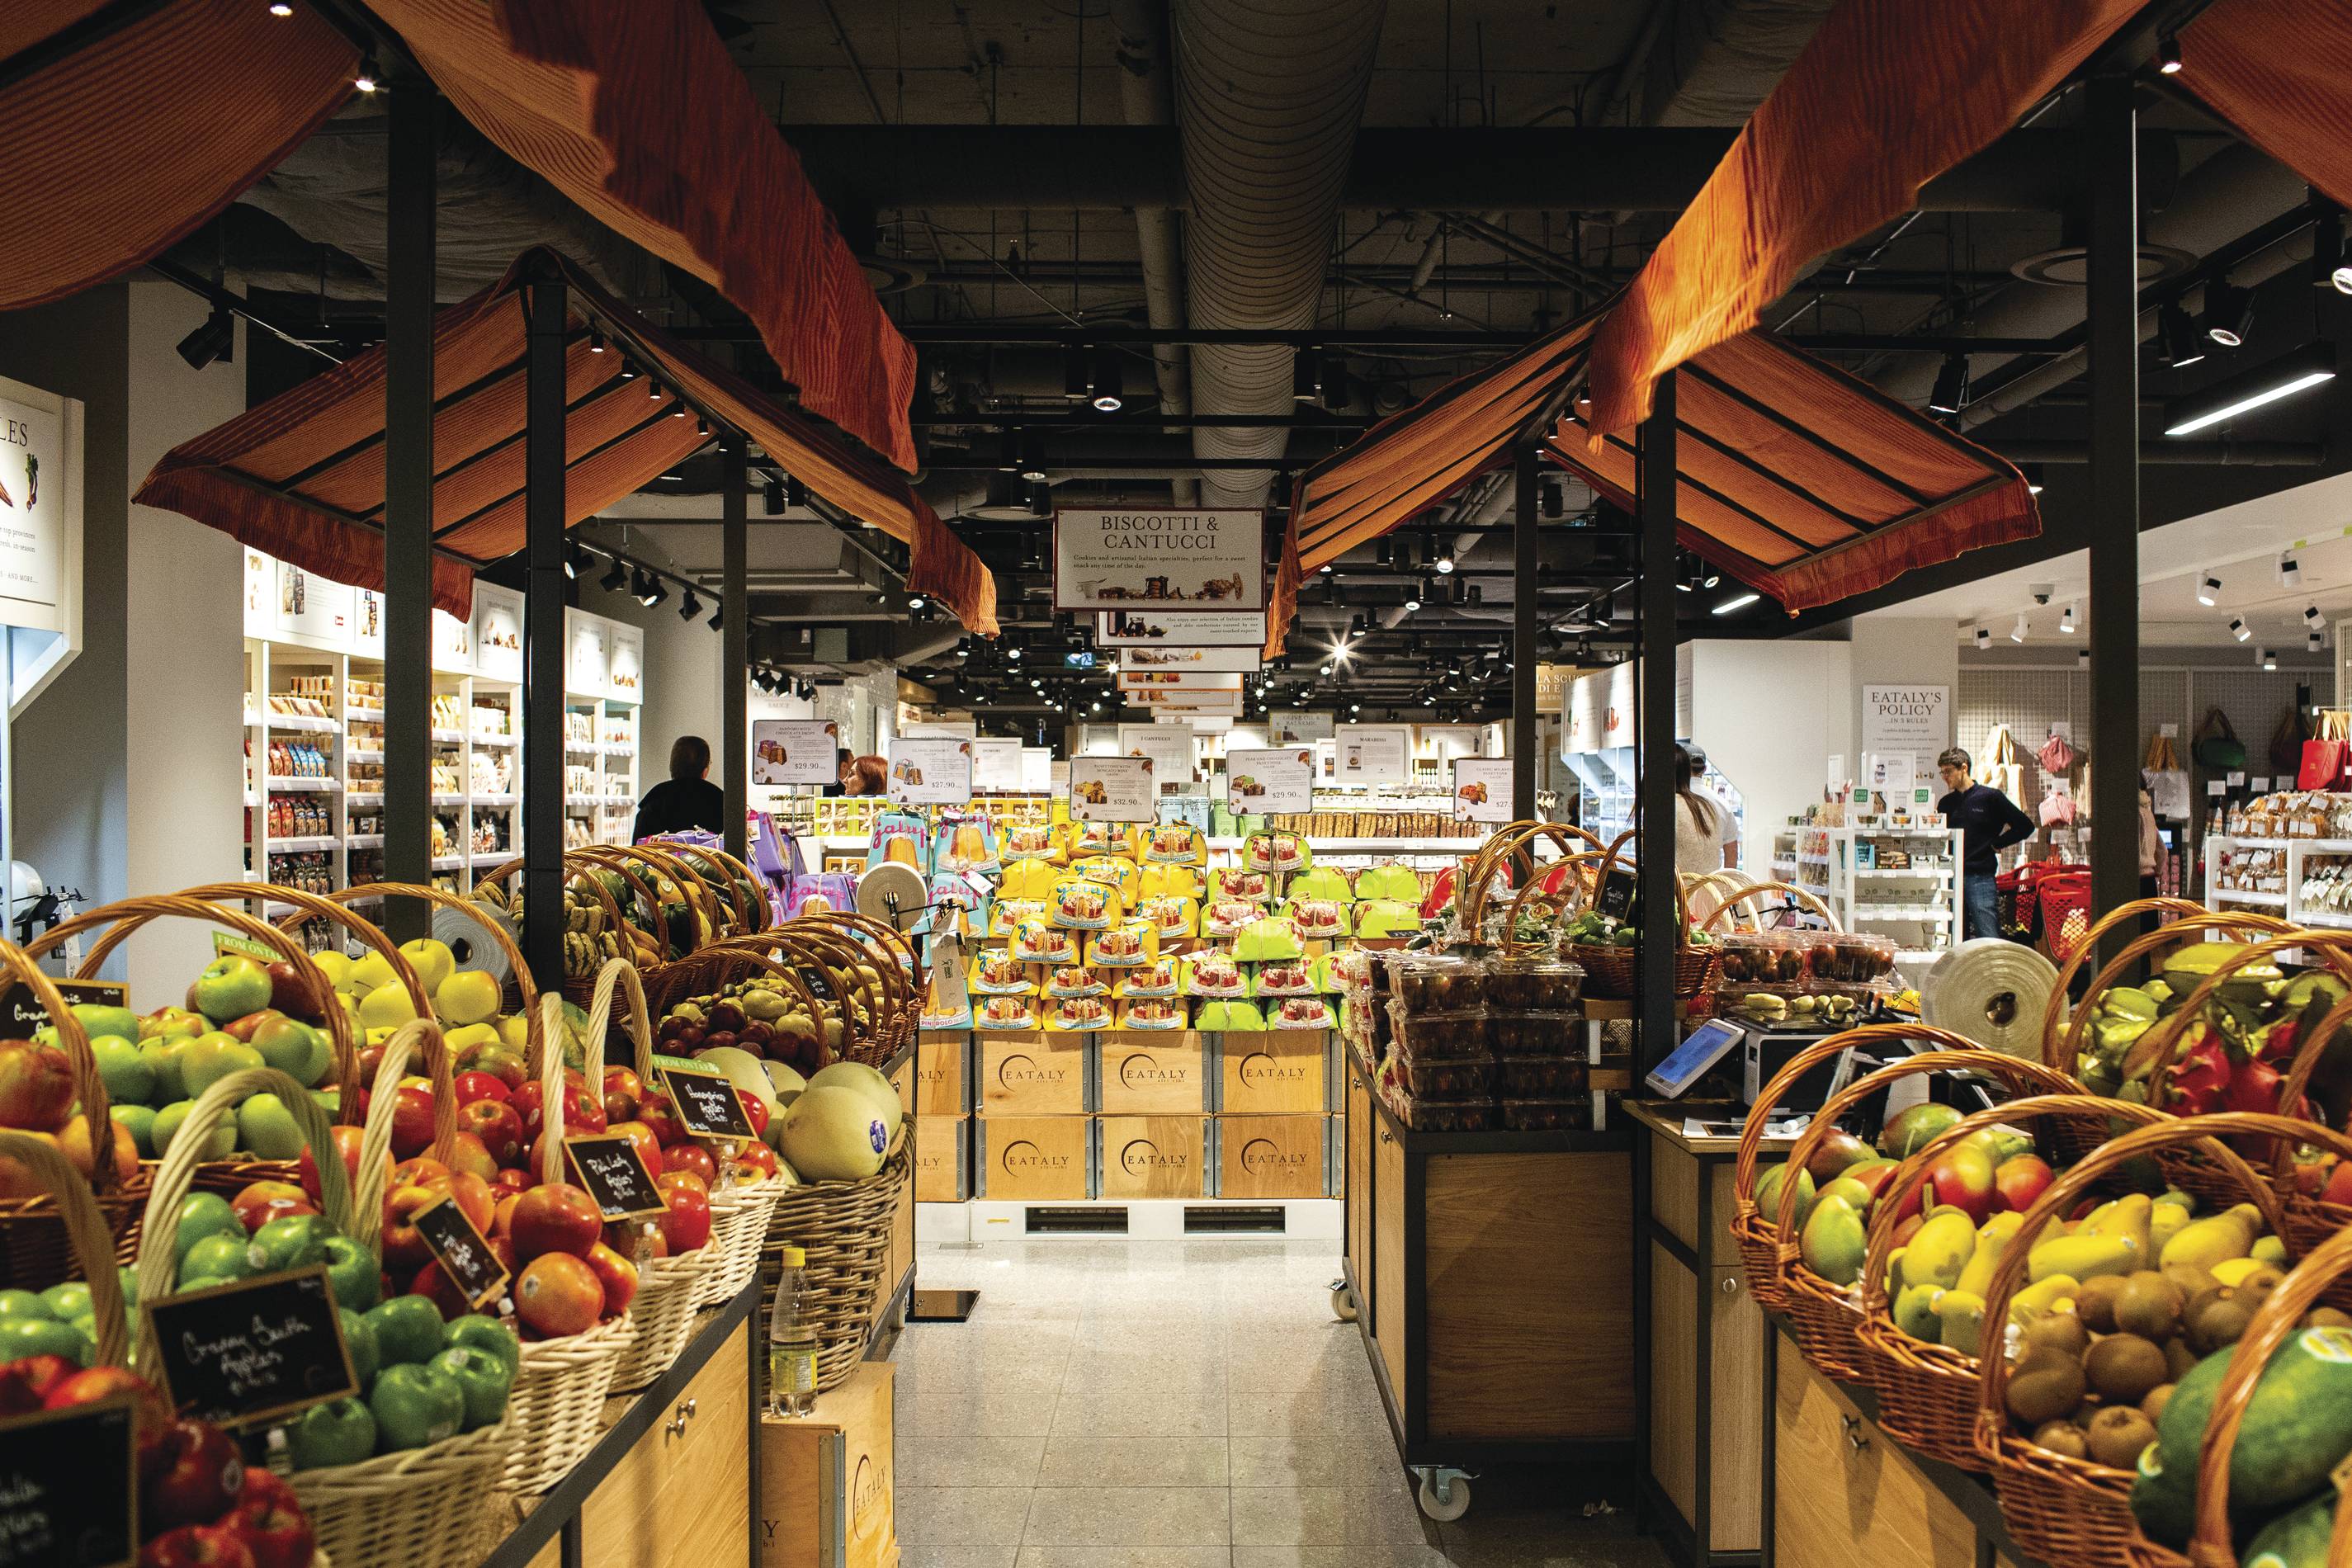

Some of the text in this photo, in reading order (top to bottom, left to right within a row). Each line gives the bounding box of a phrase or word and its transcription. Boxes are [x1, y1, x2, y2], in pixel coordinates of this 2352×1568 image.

[1101, 516, 1220, 531] BISCOTTI &
[1104, 534, 1216, 550] CANTUCCI
[1536, 674, 1551, 683] LA
[1539, 684, 1550, 693] DI
[1872, 692, 1942, 703] EATALY'S
[1879, 705, 1934, 716] POLICY
[217, 935, 286, 961] FROM ONTAR
[655, 1058, 679, 1070] FROM
[1006, 1070, 1065, 1079] EATALY
[1126, 1070, 1187, 1079] EATALY
[1246, 1068, 1306, 1078] EATALY
[1009, 1156, 1070, 1165] EATALY
[1128, 1155, 1188, 1164] EATALY
[1248, 1154, 1307, 1164] EATALY
[856, 1465, 886, 1516] EATALY
